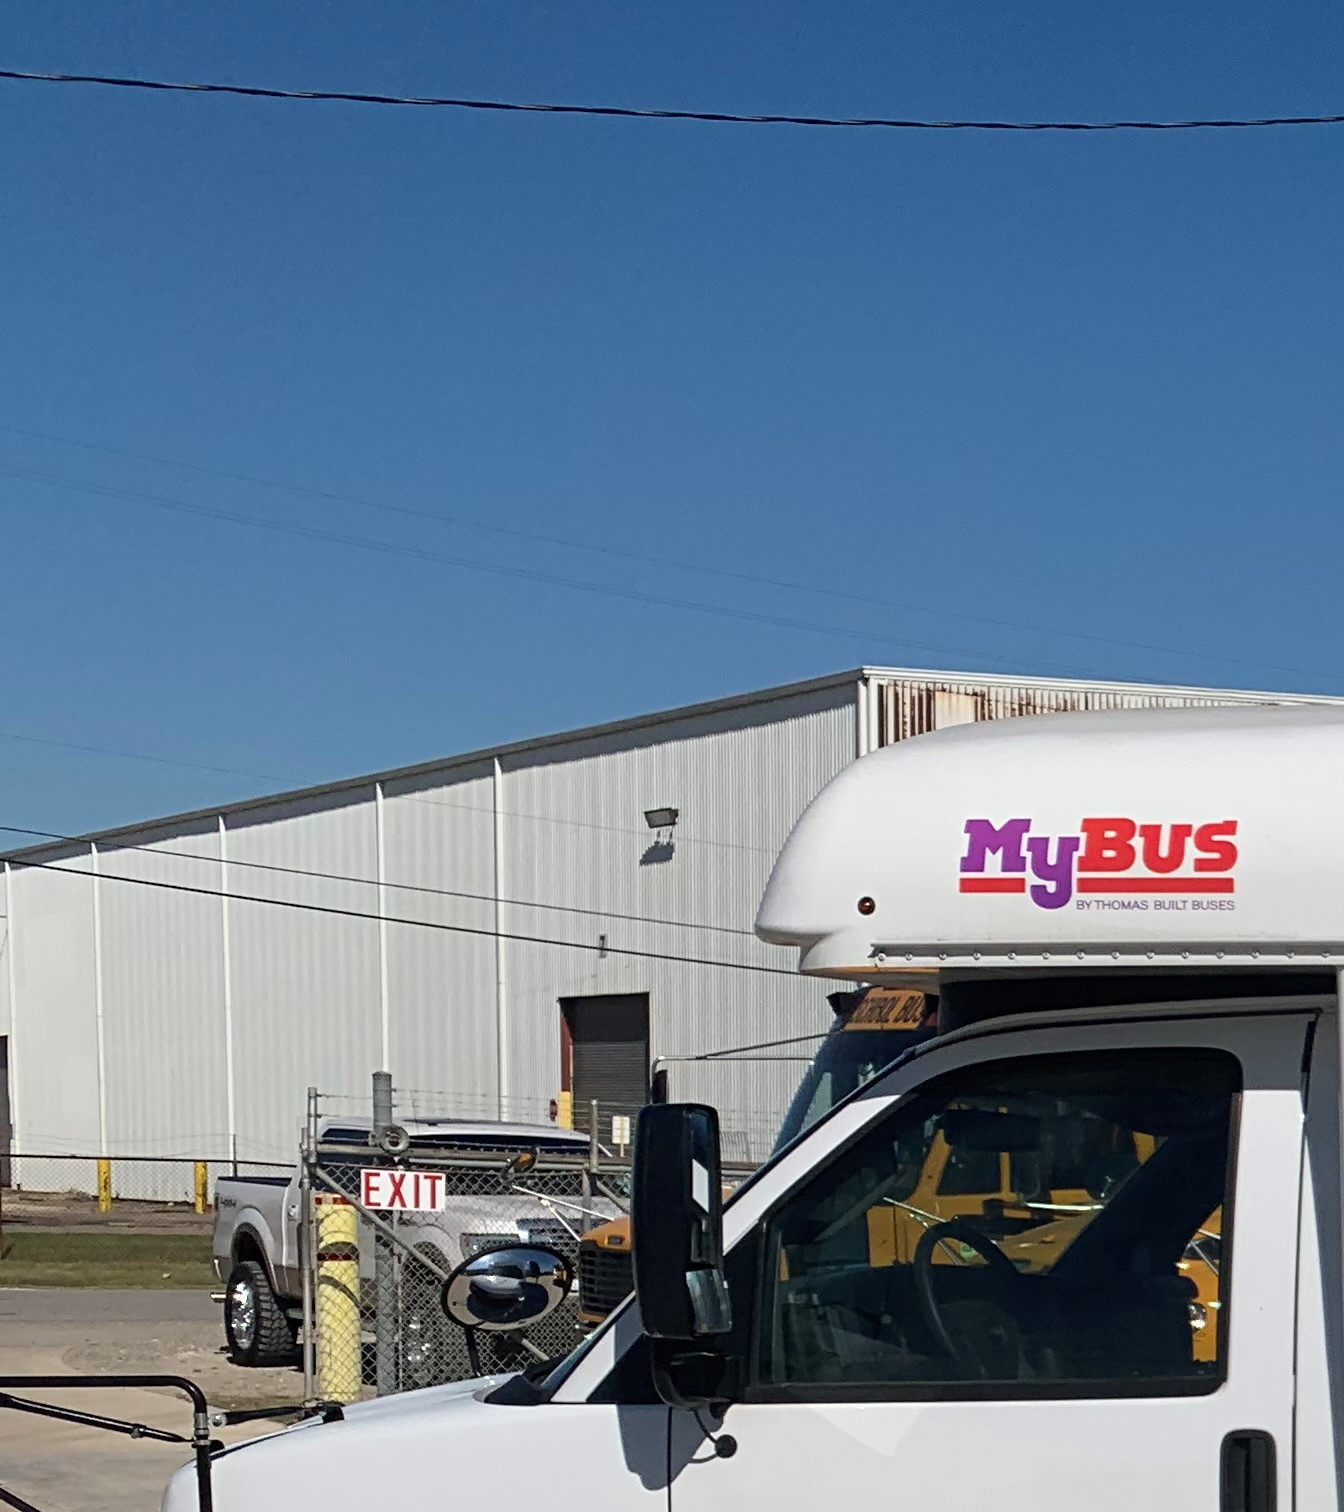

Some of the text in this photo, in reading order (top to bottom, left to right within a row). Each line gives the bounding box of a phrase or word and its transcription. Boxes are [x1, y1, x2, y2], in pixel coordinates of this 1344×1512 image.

[1076, 900, 1235, 912] BY THOMAS BUILT BUSES
[364, 1172, 443, 1209] EXIT
